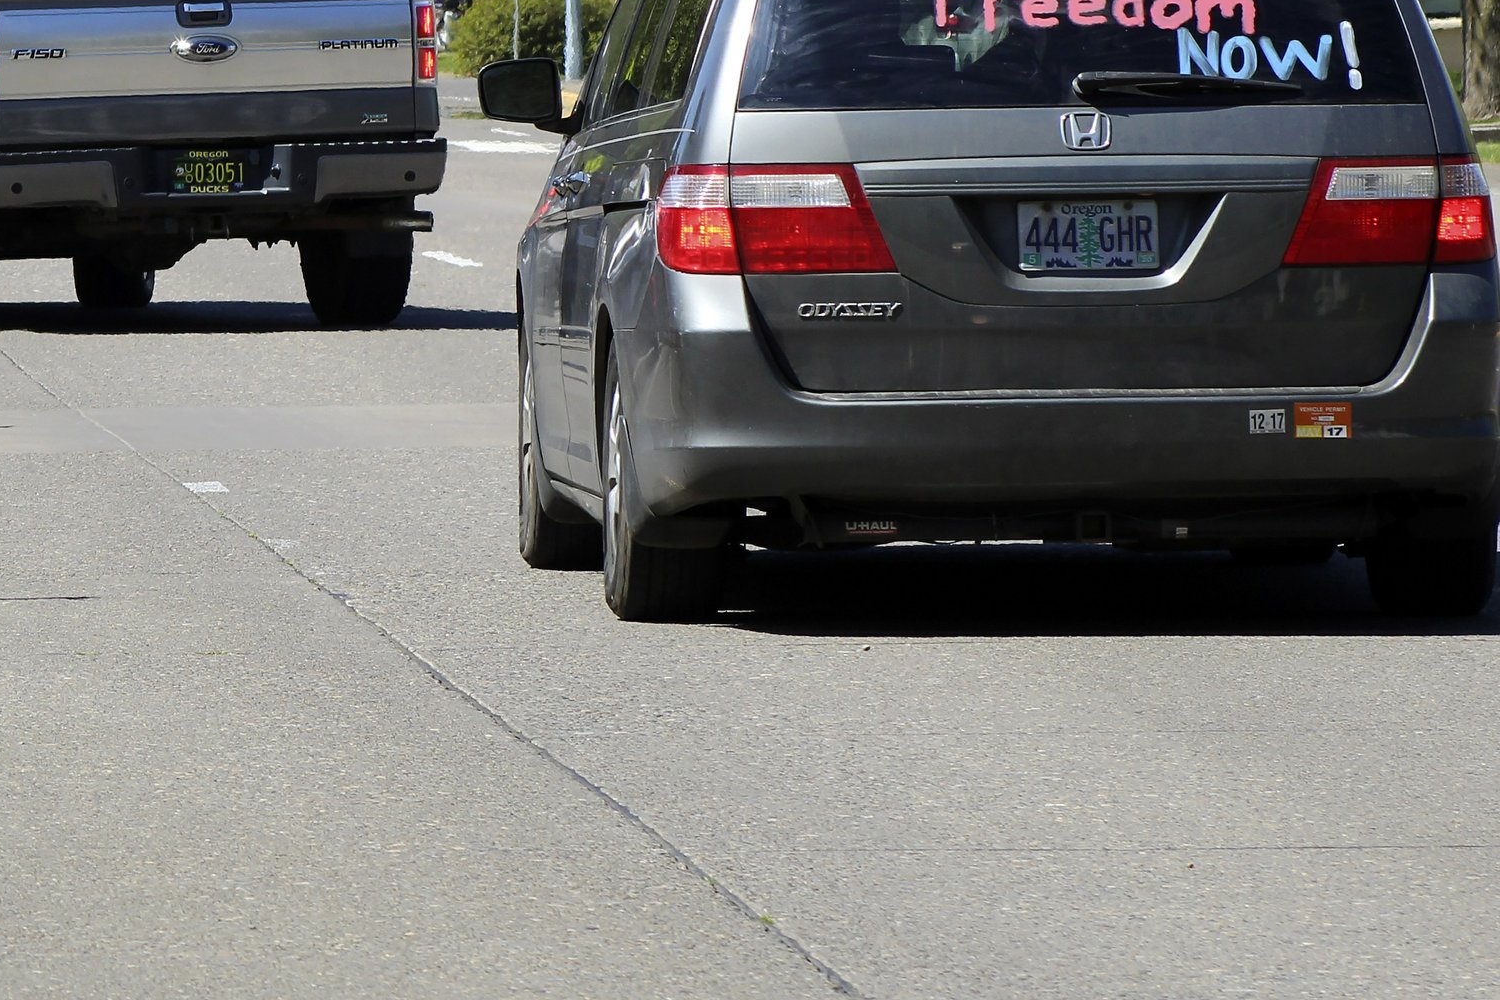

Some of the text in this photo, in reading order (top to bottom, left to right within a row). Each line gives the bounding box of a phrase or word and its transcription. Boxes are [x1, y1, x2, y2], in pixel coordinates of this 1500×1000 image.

[195, 42, 221, 54] Ford
[319, 39, 399, 50] PLATINUM
[12, 48, 67, 60] F150
[188, 150, 229, 158] OREGON
[195, 162, 243, 183] 03051
[190, 185, 230, 193] DUCKS
[1061, 203, 1113, 217] Oregon
[1025, 215, 1153, 253] 444 GHR
[1028, 255, 1036, 264] 5
[797, 303, 902, 317] ODYSSEY
[1251, 412, 1284, 430] 12 17
[1327, 427, 1343, 436] 17
[845, 521, 898, 530] U-HAUL
